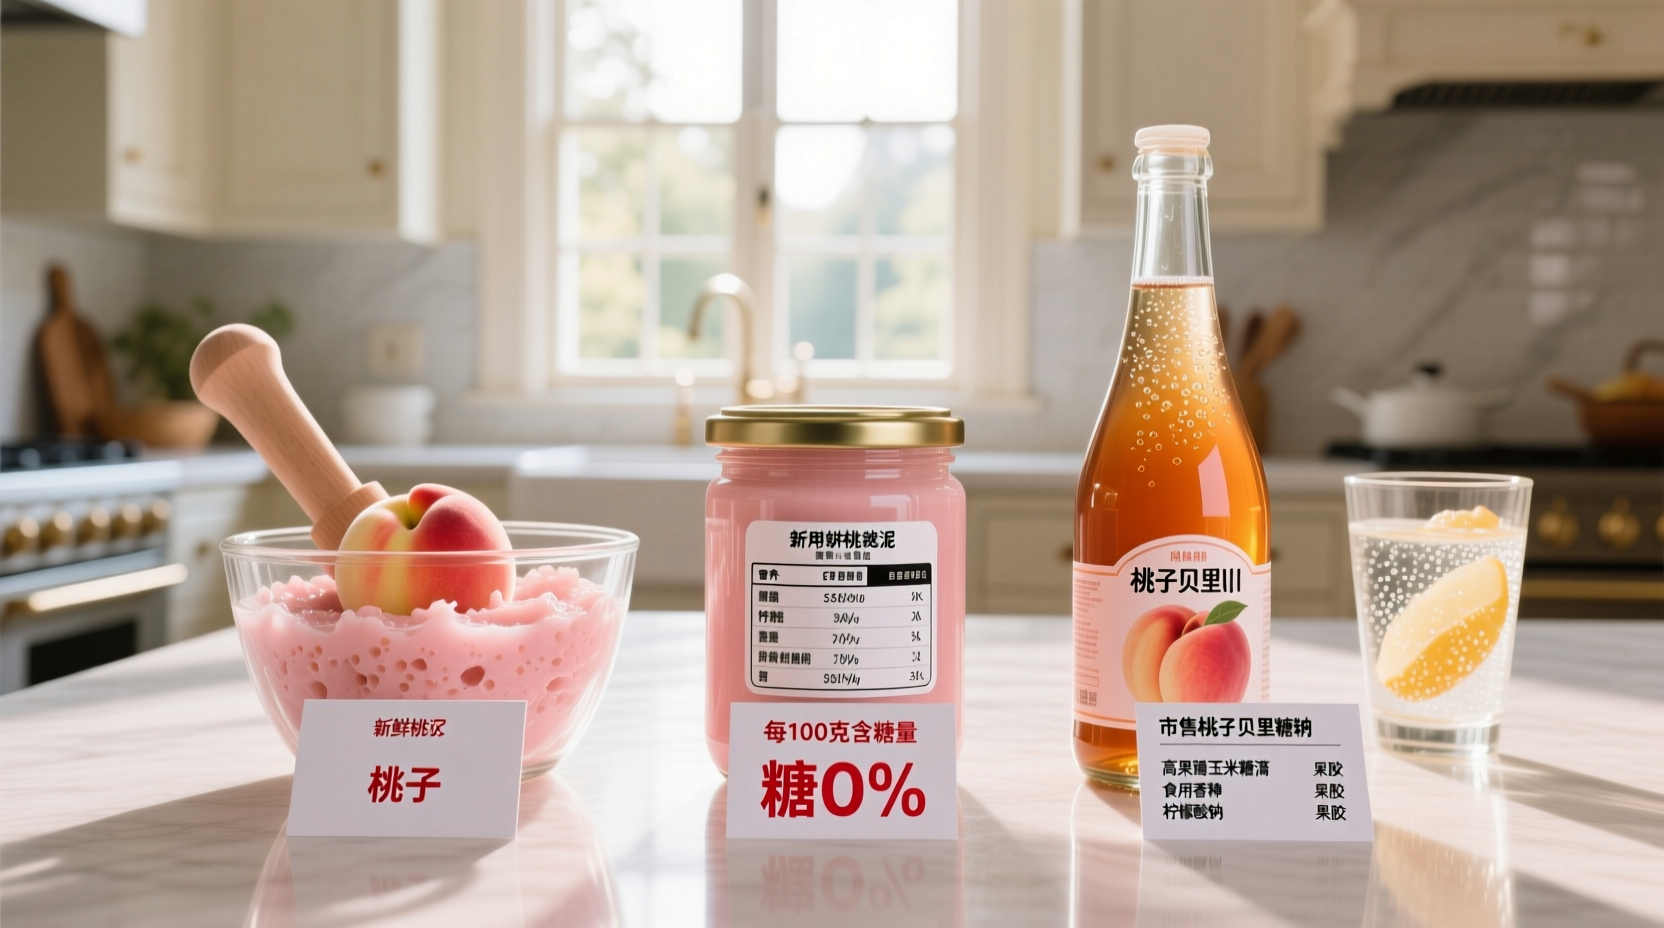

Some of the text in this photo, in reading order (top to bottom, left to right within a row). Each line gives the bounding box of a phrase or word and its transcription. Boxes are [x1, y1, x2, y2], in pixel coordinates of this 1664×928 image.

[763, 719, 918, 744] 每100克含糖量
[367, 765, 442, 804] 桃子
[760, 759, 926, 818] 糖0%
